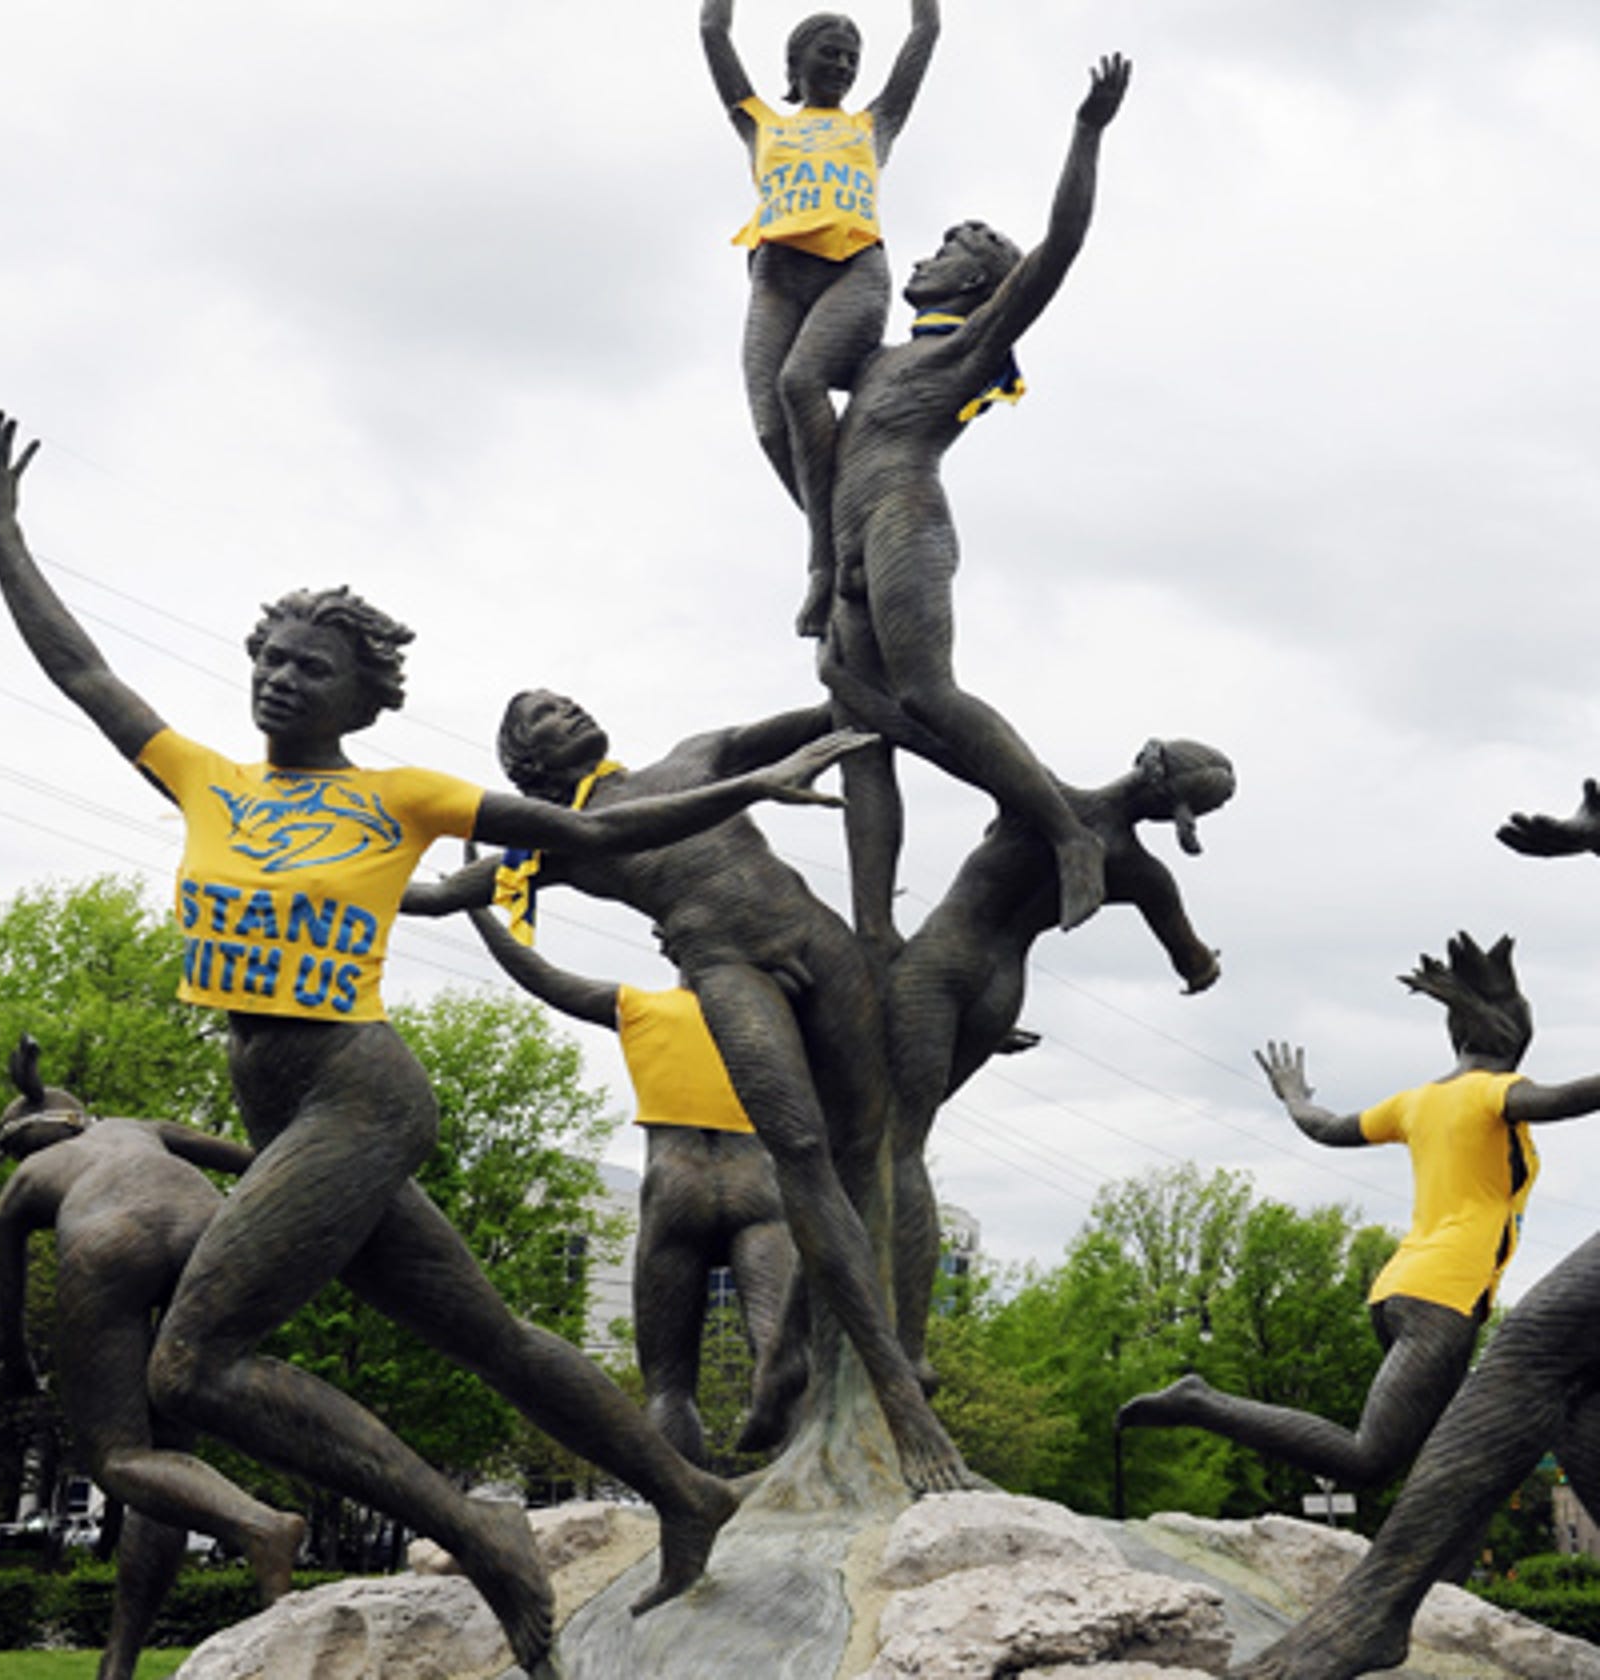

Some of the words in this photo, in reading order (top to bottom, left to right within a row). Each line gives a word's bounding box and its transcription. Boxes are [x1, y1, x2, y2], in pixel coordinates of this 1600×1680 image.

[761, 161, 874, 202] STAND
[834, 188, 874, 220] US
[181, 879, 378, 955] STAND
[294, 953, 362, 1013] US
